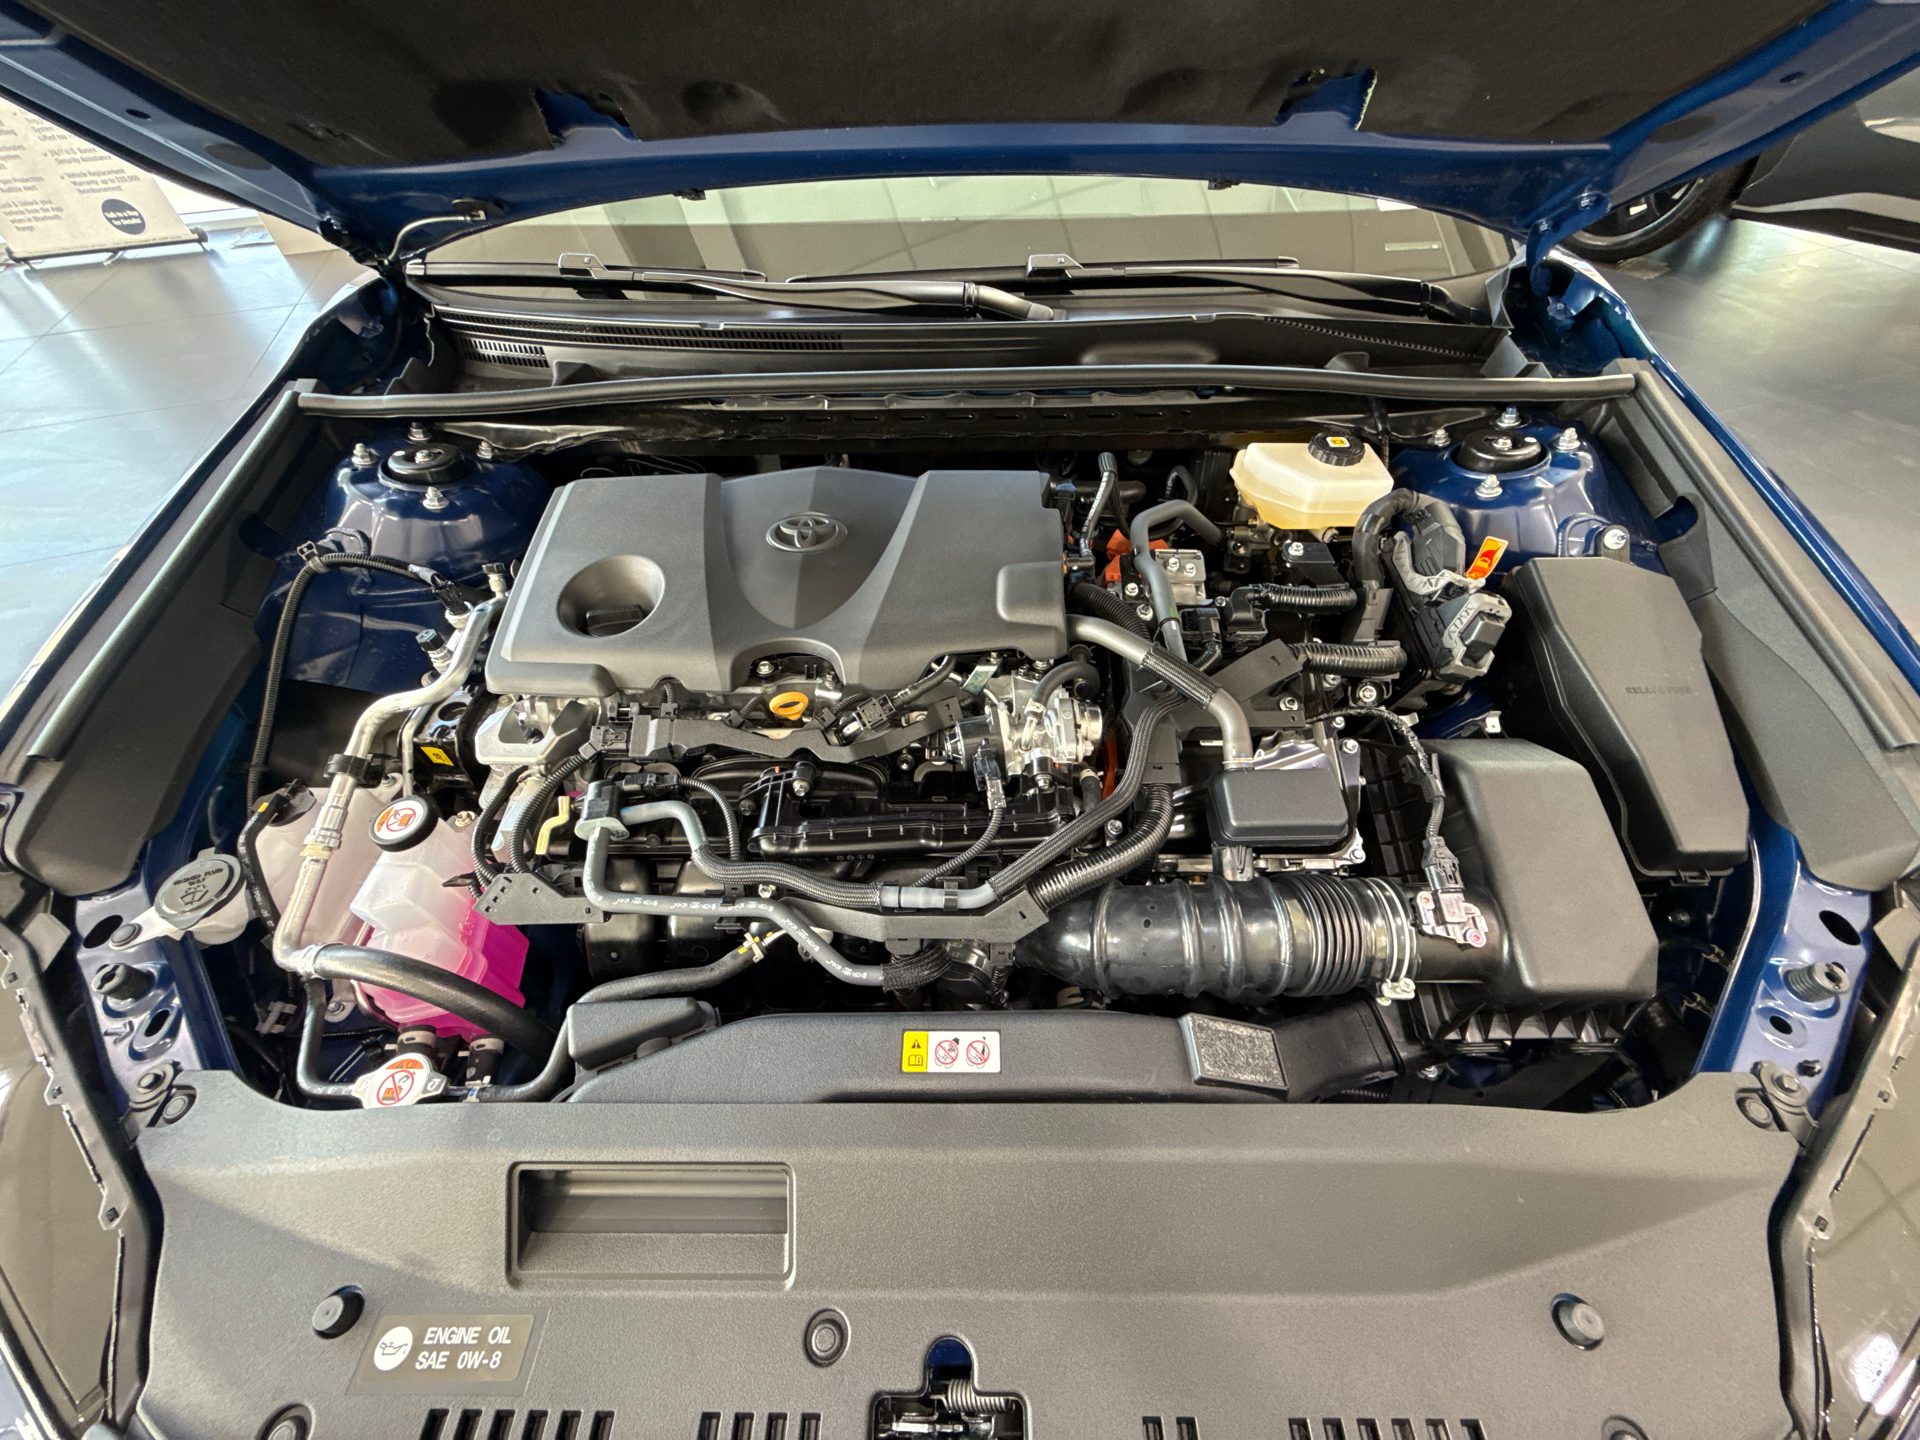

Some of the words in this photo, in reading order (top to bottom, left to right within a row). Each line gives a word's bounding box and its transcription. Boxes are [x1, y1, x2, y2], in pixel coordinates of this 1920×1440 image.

[1625, 686, 1656, 694] RELAY
[423, 1326, 481, 1345] ENGINE
[488, 1326, 512, 1345] OIL
[415, 1351, 450, 1370] SAE
[457, 1351, 502, 1370] 0W-8
